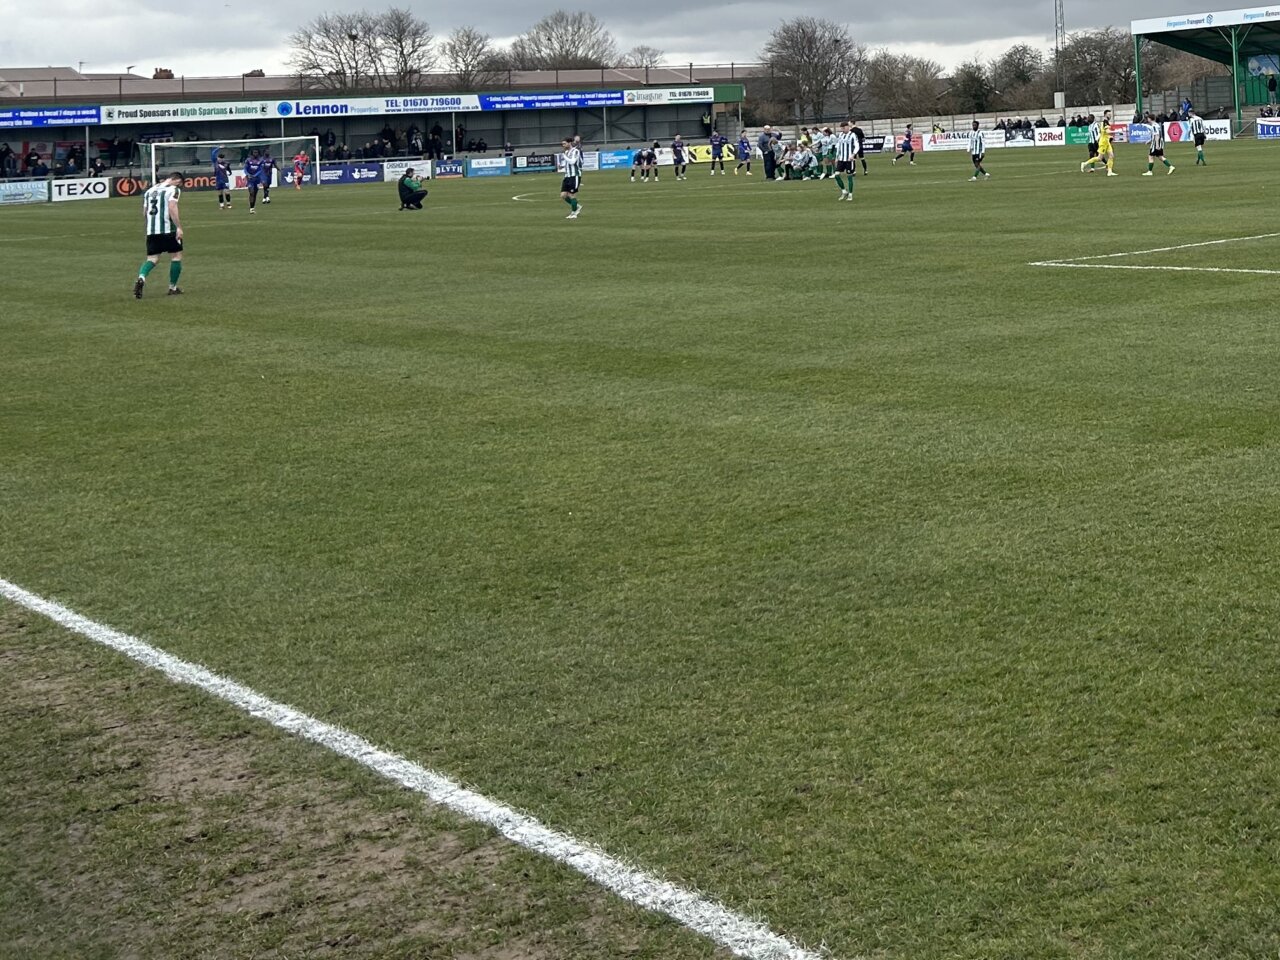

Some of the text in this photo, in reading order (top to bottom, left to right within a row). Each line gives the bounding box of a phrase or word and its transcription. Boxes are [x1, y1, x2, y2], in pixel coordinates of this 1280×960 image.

[385, 97, 461, 108] TEL: 01670 719600
[118, 105, 258, 119] Proud Sponsors of Blyth Spartans & Juniors
[295, 102, 349, 116] Lennon
[1037, 132, 1063, 142] 32Red
[528, 155, 552, 164] insight
[436, 166, 462, 174] BLYTH
[54, 181, 107, 196] TEXO
[149, 199, 158, 216] 3
